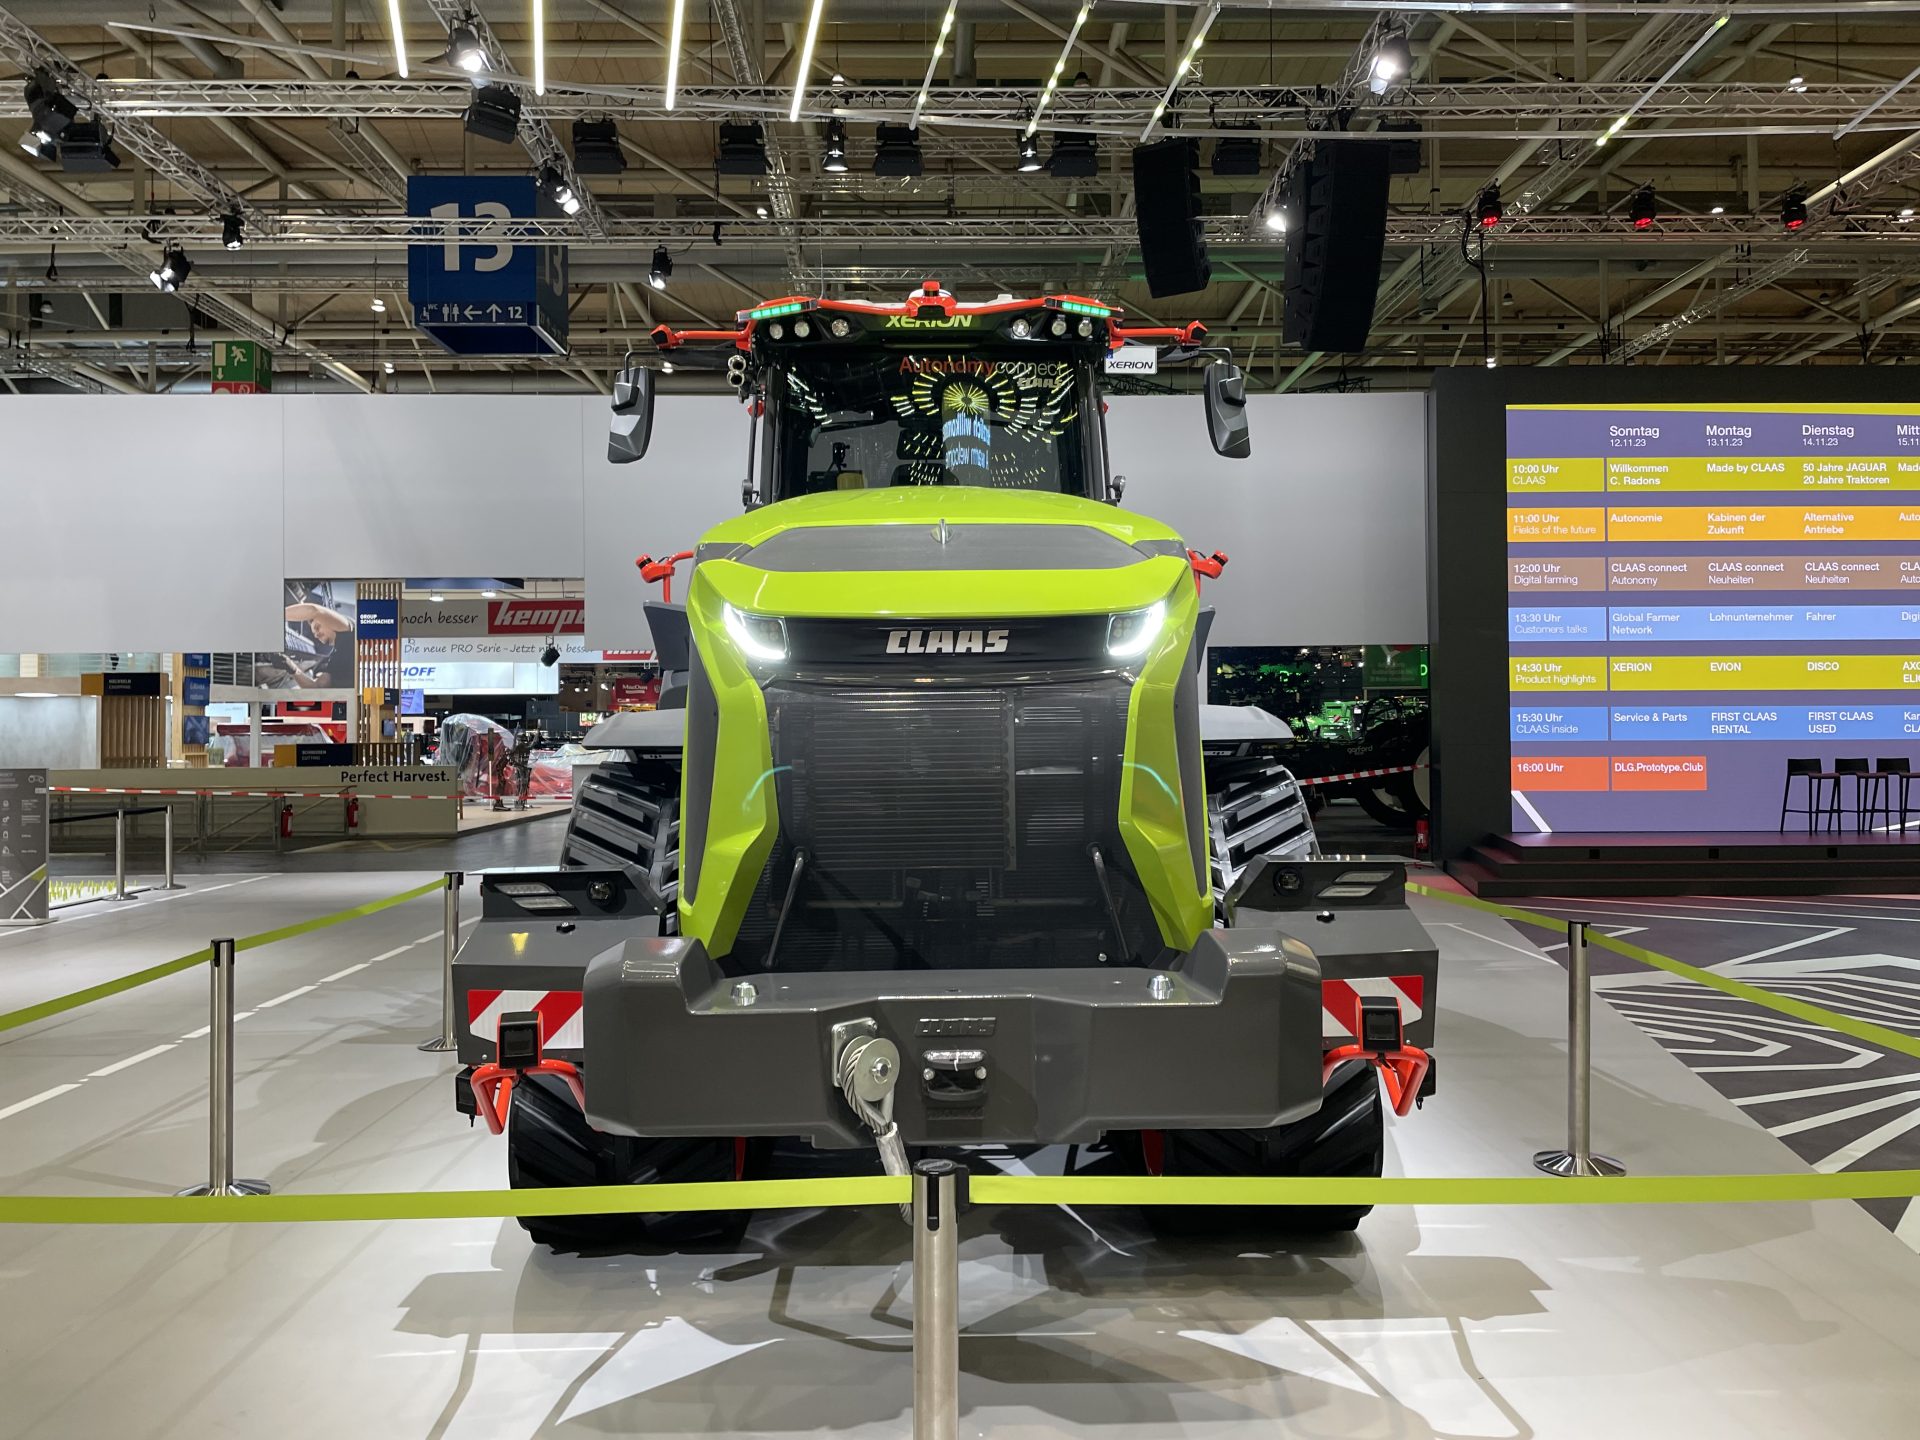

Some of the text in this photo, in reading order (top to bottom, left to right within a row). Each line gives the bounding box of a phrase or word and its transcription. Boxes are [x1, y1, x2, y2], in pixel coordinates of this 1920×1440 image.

[430, 201, 514, 272] 13
[508, 306, 523, 319] 12
[1108, 361, 1154, 370] XERION
[1610, 425, 1660, 438] Sonntag
[1706, 425, 1752, 437] Montag
[1802, 425, 1854, 437] Dienstag
[1610, 439, 1646, 447] 12.11.23
[1803, 438, 1838, 446] 14.11.23
[1513, 465, 1559, 473] 10:00 Uhr
[1610, 464, 1668, 473] Willkommen
[1707, 464, 1785, 473] Made by CLAAS
[1803, 463, 1887, 472] 50 Jahre JAGUAR
[1898, 463, 1920, 472] Mad
[1513, 476, 1546, 484] CLAAS
[1610, 477, 1661, 485] C. Radons
[1803, 476, 1889, 484] 20 Jahre Traktoren
[1514, 515, 1559, 523] 11:00 Uhr
[1611, 514, 1662, 522] Autonomie
[1708, 513, 1766, 522] Kabinen der
[1804, 513, 1854, 521] Alternative
[1514, 526, 1596, 534] Fields of the future
[1708, 526, 1744, 534] Zukunft
[1804, 525, 1844, 534] Antriebe
[1514, 564, 1561, 573] 12:00 Uhr
[1611, 564, 1687, 572] CLAAS connect
[1708, 563, 1784, 571] CLAAS connect
[1805, 562, 1879, 571] CLAAS connect
[1514, 575, 1578, 585] Digital farming
[1612, 576, 1657, 586] Autonomy
[1709, 576, 1753, 584] Neuheiten
[1806, 575, 1849, 583] Neuheiten
[401, 610, 478, 624] noch besser
[1515, 614, 1561, 622] 13:30 Uhr
[1613, 613, 1680, 622] Global Farmer
[1709, 613, 1794, 621] Lohnunternehmer
[1806, 613, 1836, 621] Fahrer
[1515, 625, 1588, 634] Customers talks
[1613, 626, 1652, 634] Network
[886, 629, 1009, 654] CLAAS
[404, 644, 420, 653] Die
[423, 645, 447, 653] neue
[450, 644, 474, 653] PRO
[477, 643, 502, 653] Serie
[509, 644, 536, 653] Jetzt
[1515, 664, 1562, 672] 14:30 Uhr
[1613, 663, 1652, 671] XERION
[1710, 663, 1741, 671] EVION
[1808, 662, 1839, 670] DISCO
[1516, 675, 1596, 685] Product highlights
[1516, 714, 1563, 722] 15:30 Uhr
[1614, 713, 1687, 722] Service & Parts
[1712, 713, 1777, 721] FIRST CLAAS
[1808, 712, 1874, 720] FIRST CLAAS
[1516, 725, 1578, 733] CLAAS inside
[1712, 725, 1751, 734] RENTAL
[1809, 725, 1836, 733] USED
[1517, 764, 1564, 772] 16:00 Uhr
[1615, 763, 1703, 773] DLG.Prototype.Club
[341, 770, 450, 783] Perfect Harvest.
